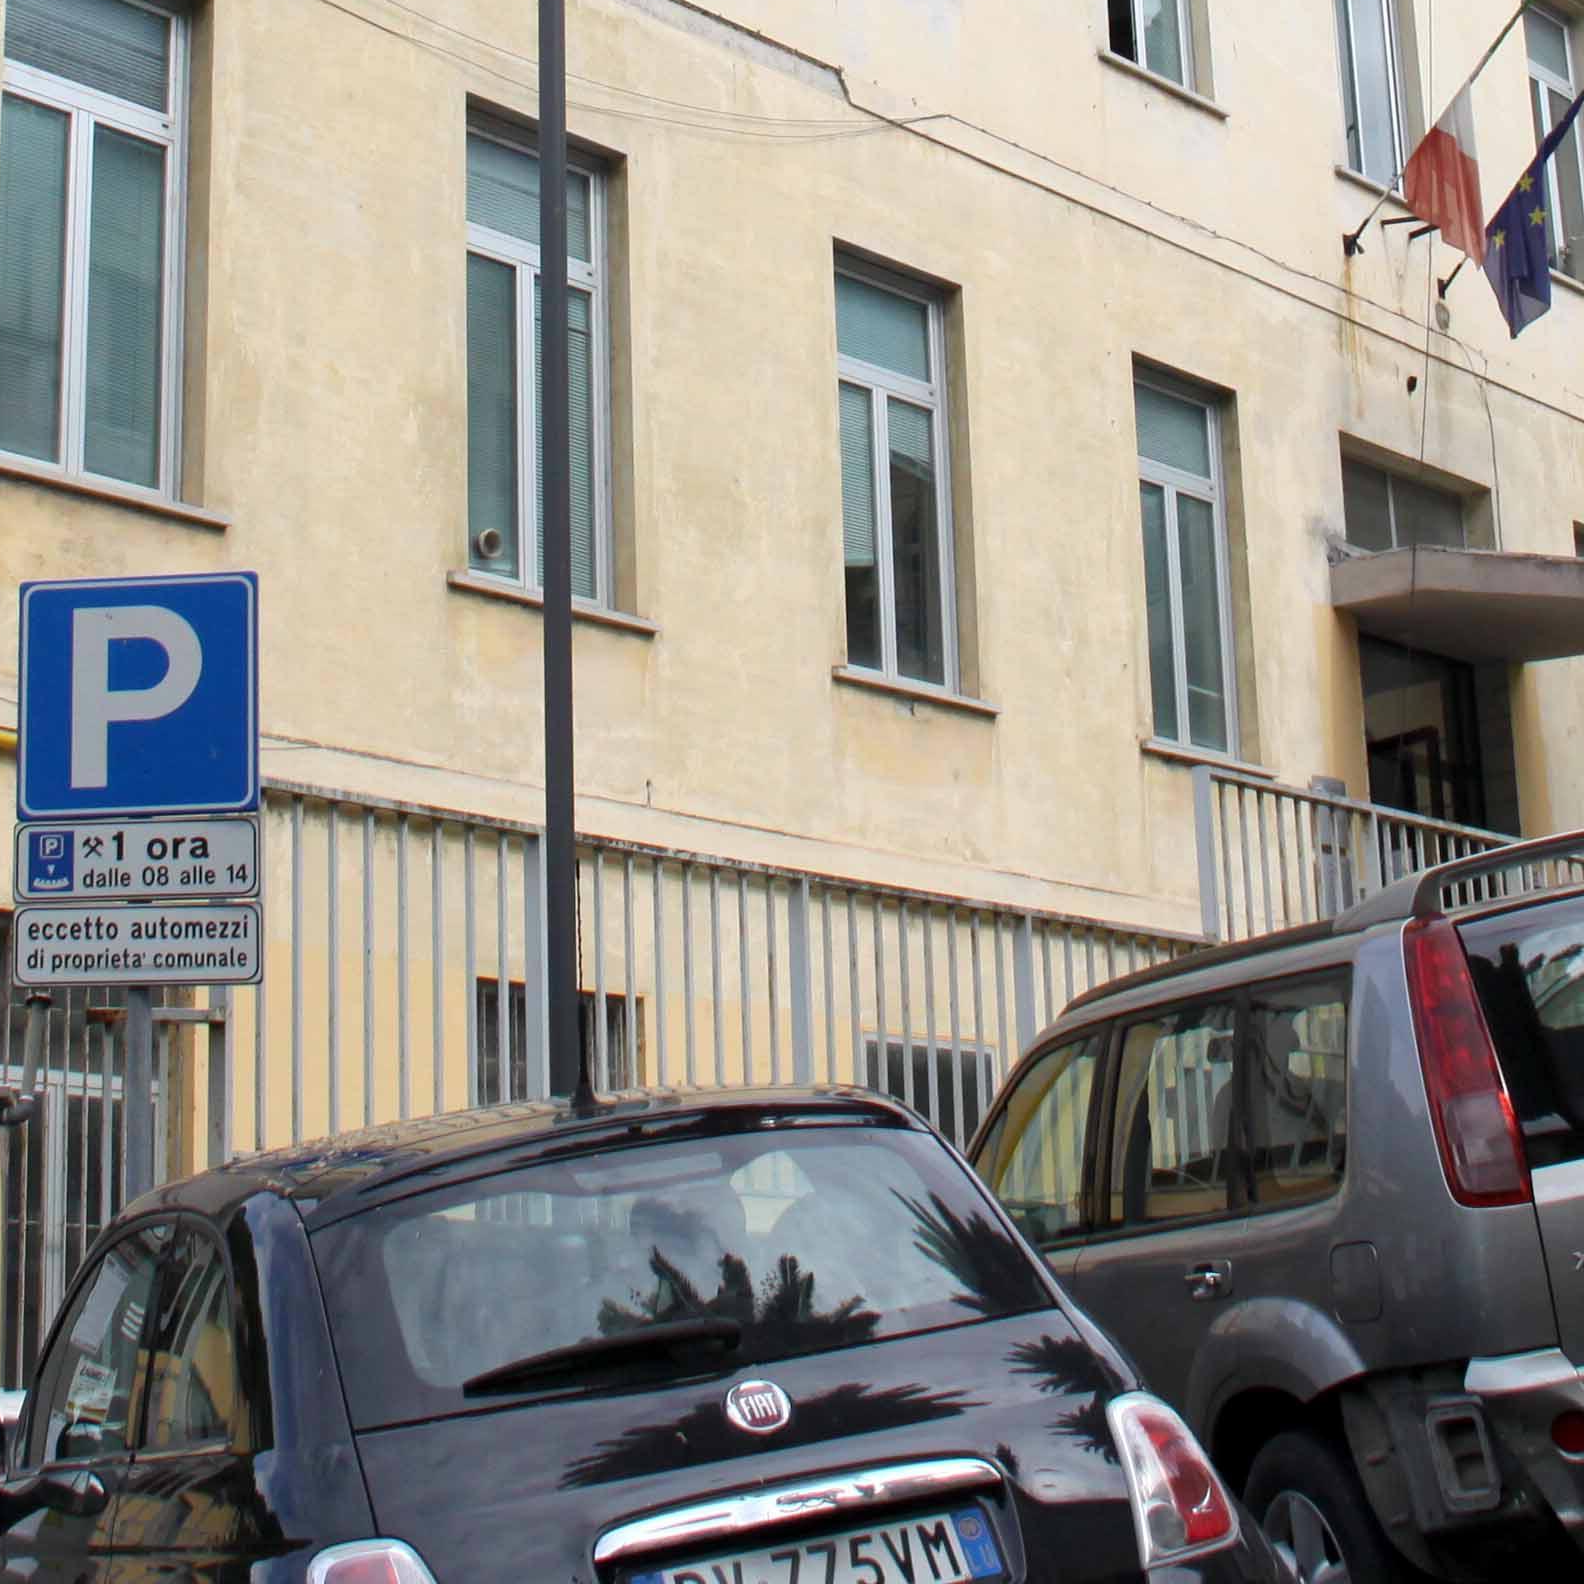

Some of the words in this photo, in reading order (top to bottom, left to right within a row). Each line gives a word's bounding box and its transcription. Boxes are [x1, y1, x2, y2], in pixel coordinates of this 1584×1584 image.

[70, 605, 203, 789] P
[112, 831, 125, 861] 1
[146, 835, 210, 860] ora
[82, 868, 132, 889] dalle
[141, 866, 169, 887] 08
[179, 865, 217, 886] alle
[226, 864, 249, 884] 14
[28, 917, 119, 940] eccetto
[130, 914, 249, 940] automezzi
[27, 948, 45, 969] di
[51, 947, 147, 973] proprieta'
[152, 946, 249, 969] comunale
[739, 1392, 782, 1422] FIAT
